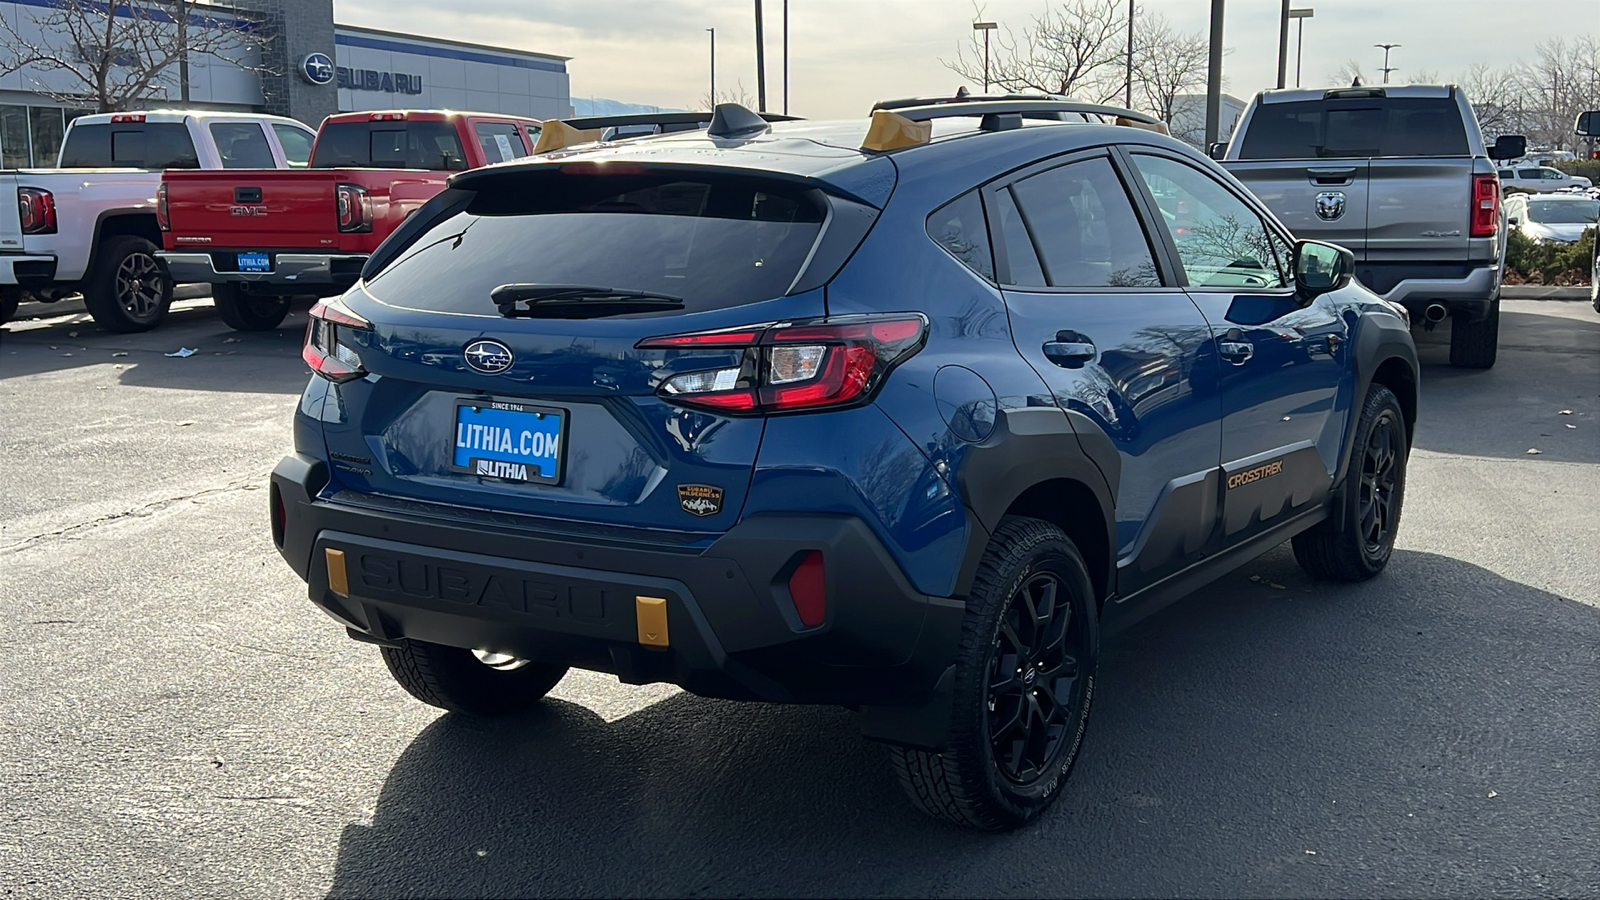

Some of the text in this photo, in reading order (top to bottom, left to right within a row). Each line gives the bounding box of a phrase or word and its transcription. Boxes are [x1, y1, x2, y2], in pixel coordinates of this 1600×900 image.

[336, 66, 422, 95] SUBARU
[230, 206, 268, 216] GMC
[237, 258, 269, 267] LITHIA.COM
[491, 402, 524, 412] SINCE 1946
[456, 422, 560, 460] LITHIA.COM
[487, 461, 528, 480] LITHIA
[1227, 460, 1283, 489] CROSSTREK
[679, 490, 720, 499] WILDERNESS
[360, 553, 613, 627] SUBARU
